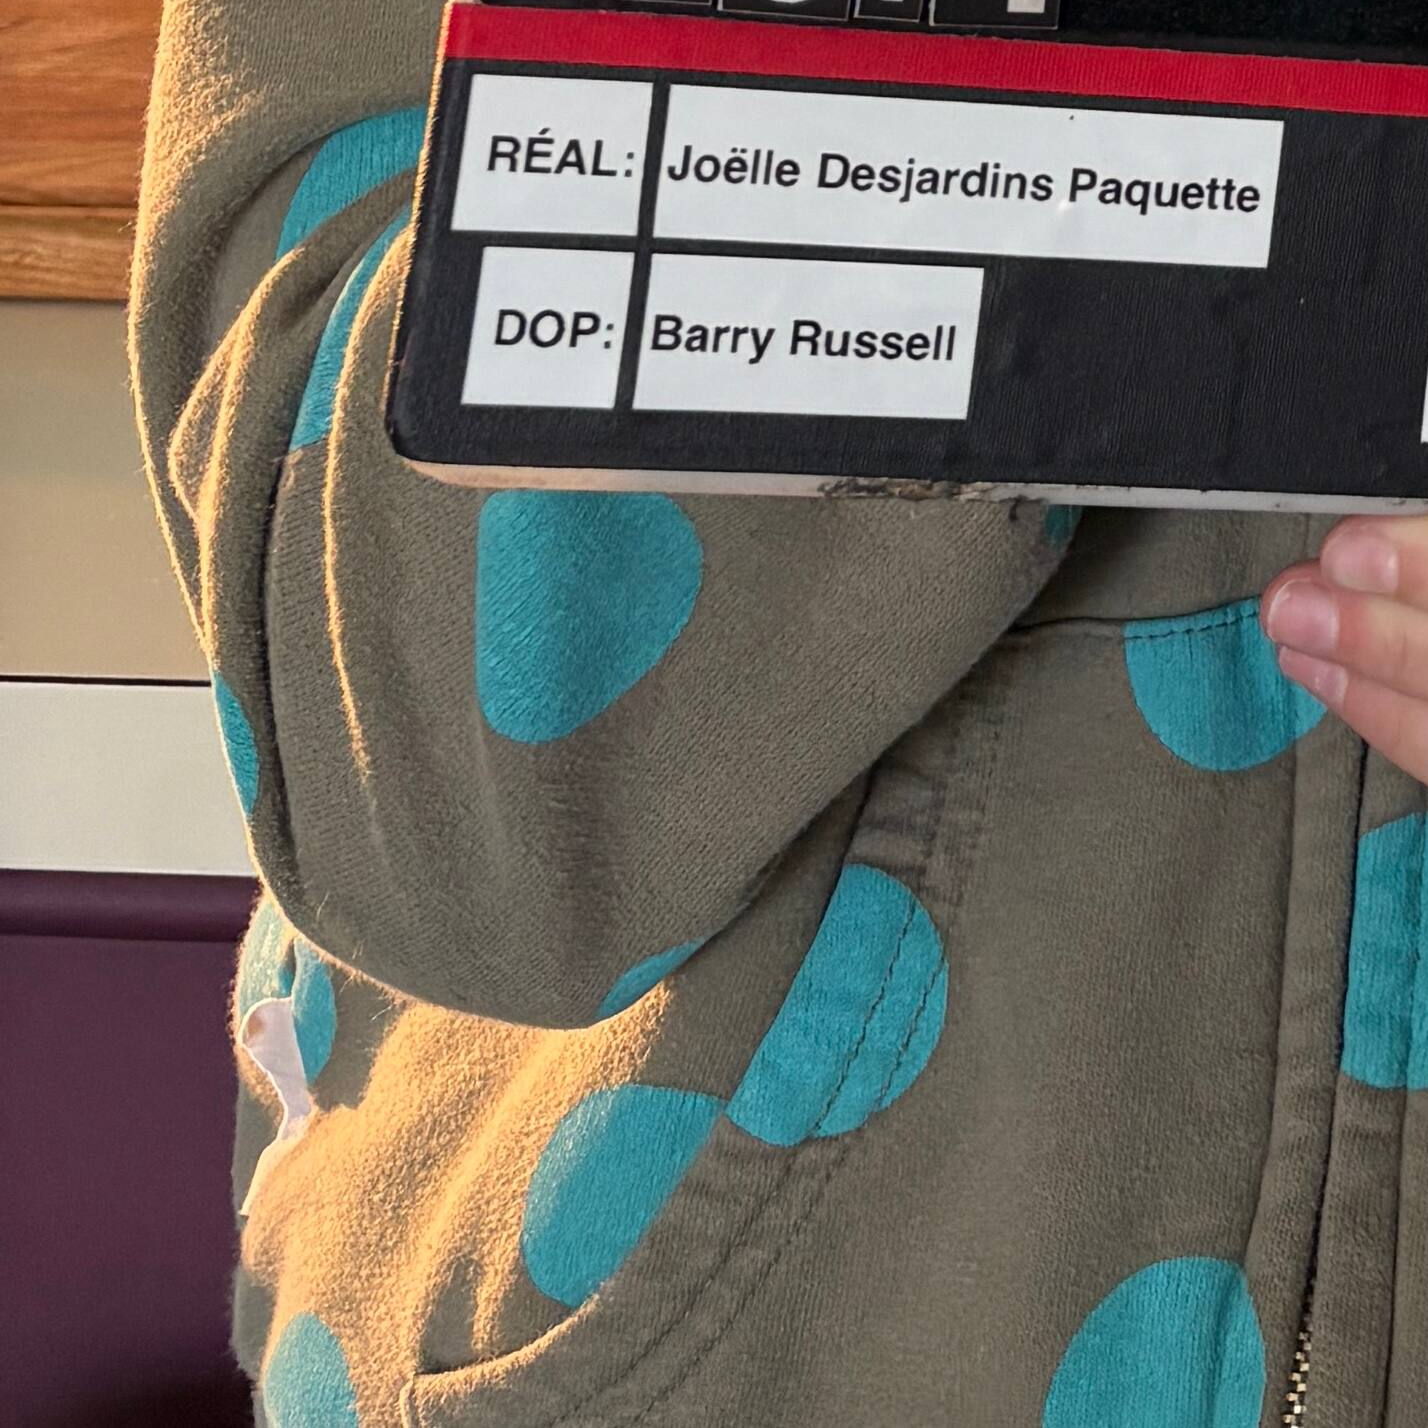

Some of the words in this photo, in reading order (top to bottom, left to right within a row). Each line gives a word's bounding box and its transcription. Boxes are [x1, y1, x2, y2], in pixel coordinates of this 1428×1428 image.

[488, 128, 633, 177] RÉAL:
[667, 141, 800, 188] Joëlle
[818, 153, 1053, 204] Desjardins
[1068, 168, 1260, 216] Paquette
[495, 310, 613, 348] DOP:
[651, 315, 775, 364] Barry
[790, 320, 955, 361] Russell
